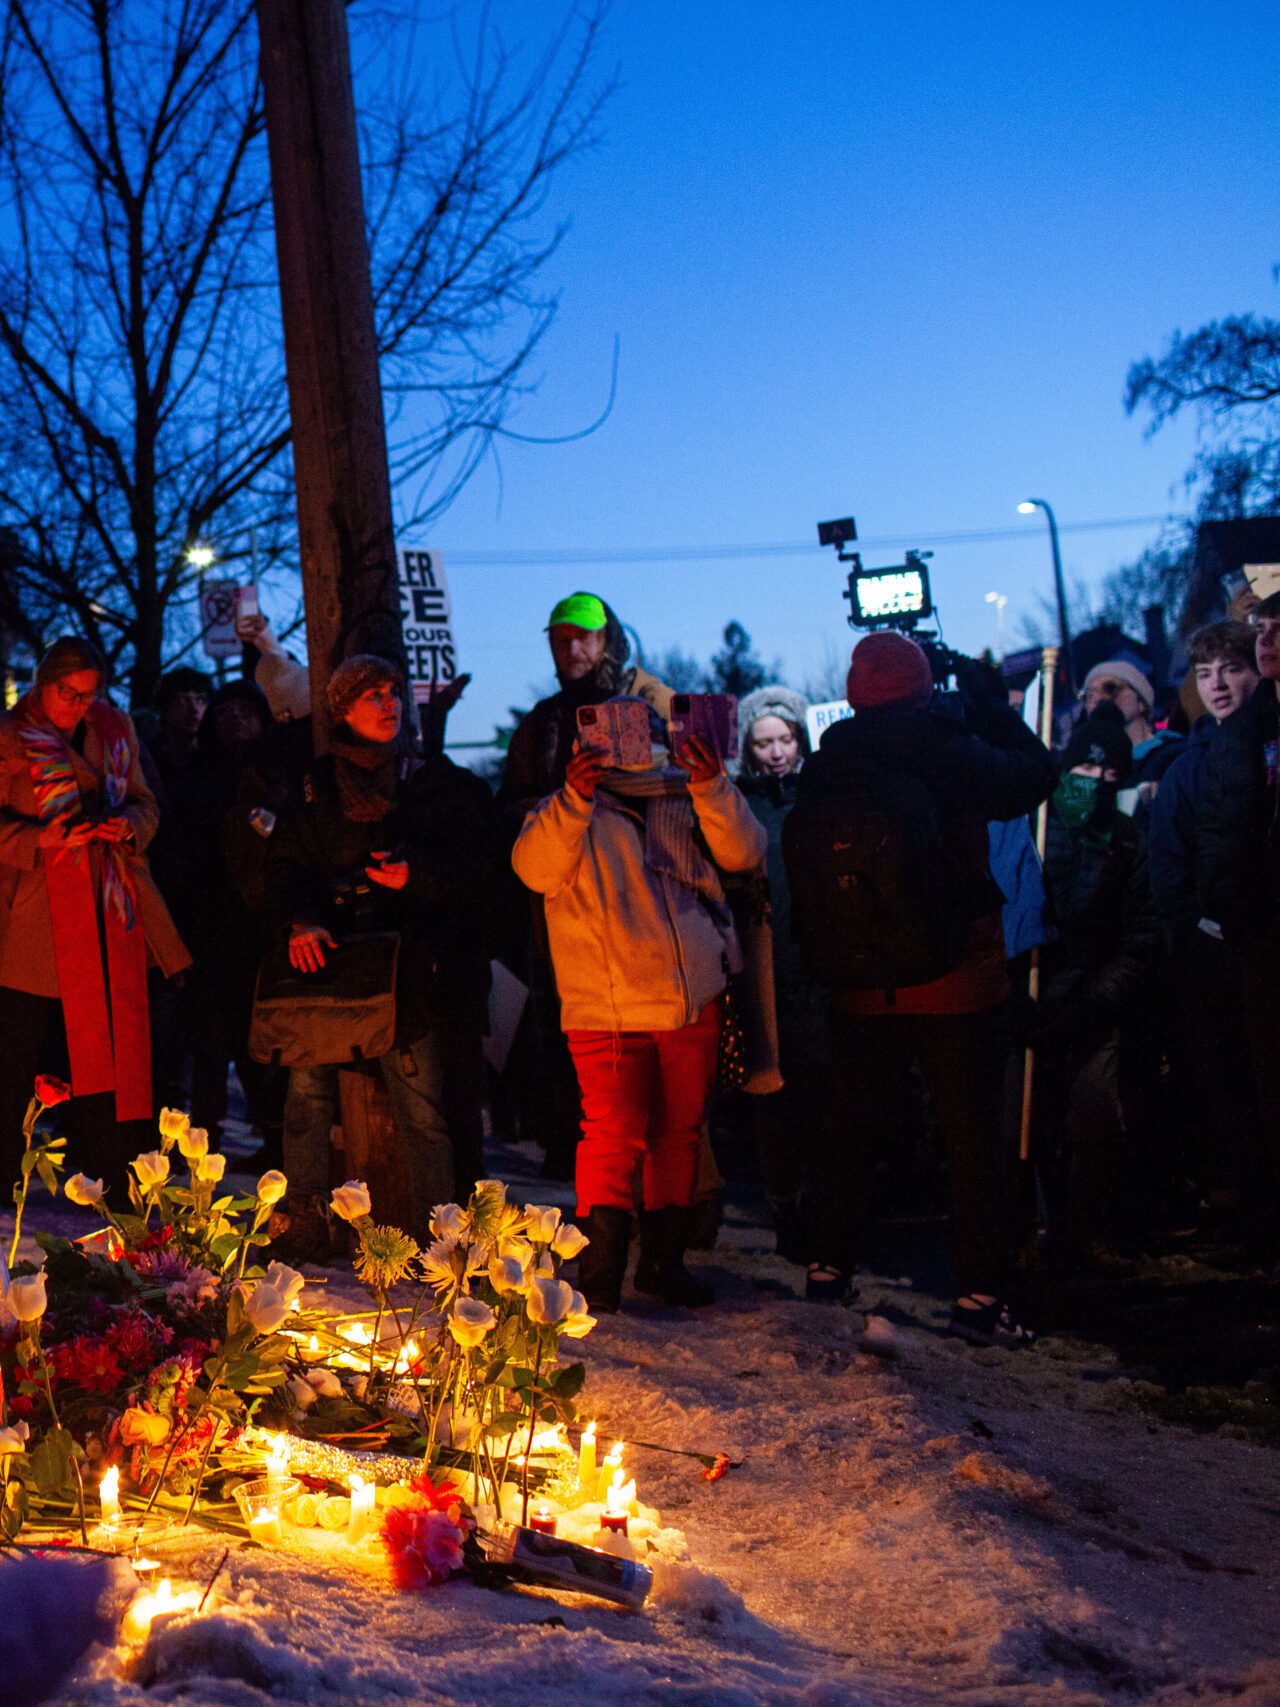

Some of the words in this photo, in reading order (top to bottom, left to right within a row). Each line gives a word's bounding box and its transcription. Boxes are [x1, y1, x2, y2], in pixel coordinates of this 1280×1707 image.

[400, 552, 436, 587] ER
[400, 589, 448, 624] E
[405, 628, 452, 642] OUR
